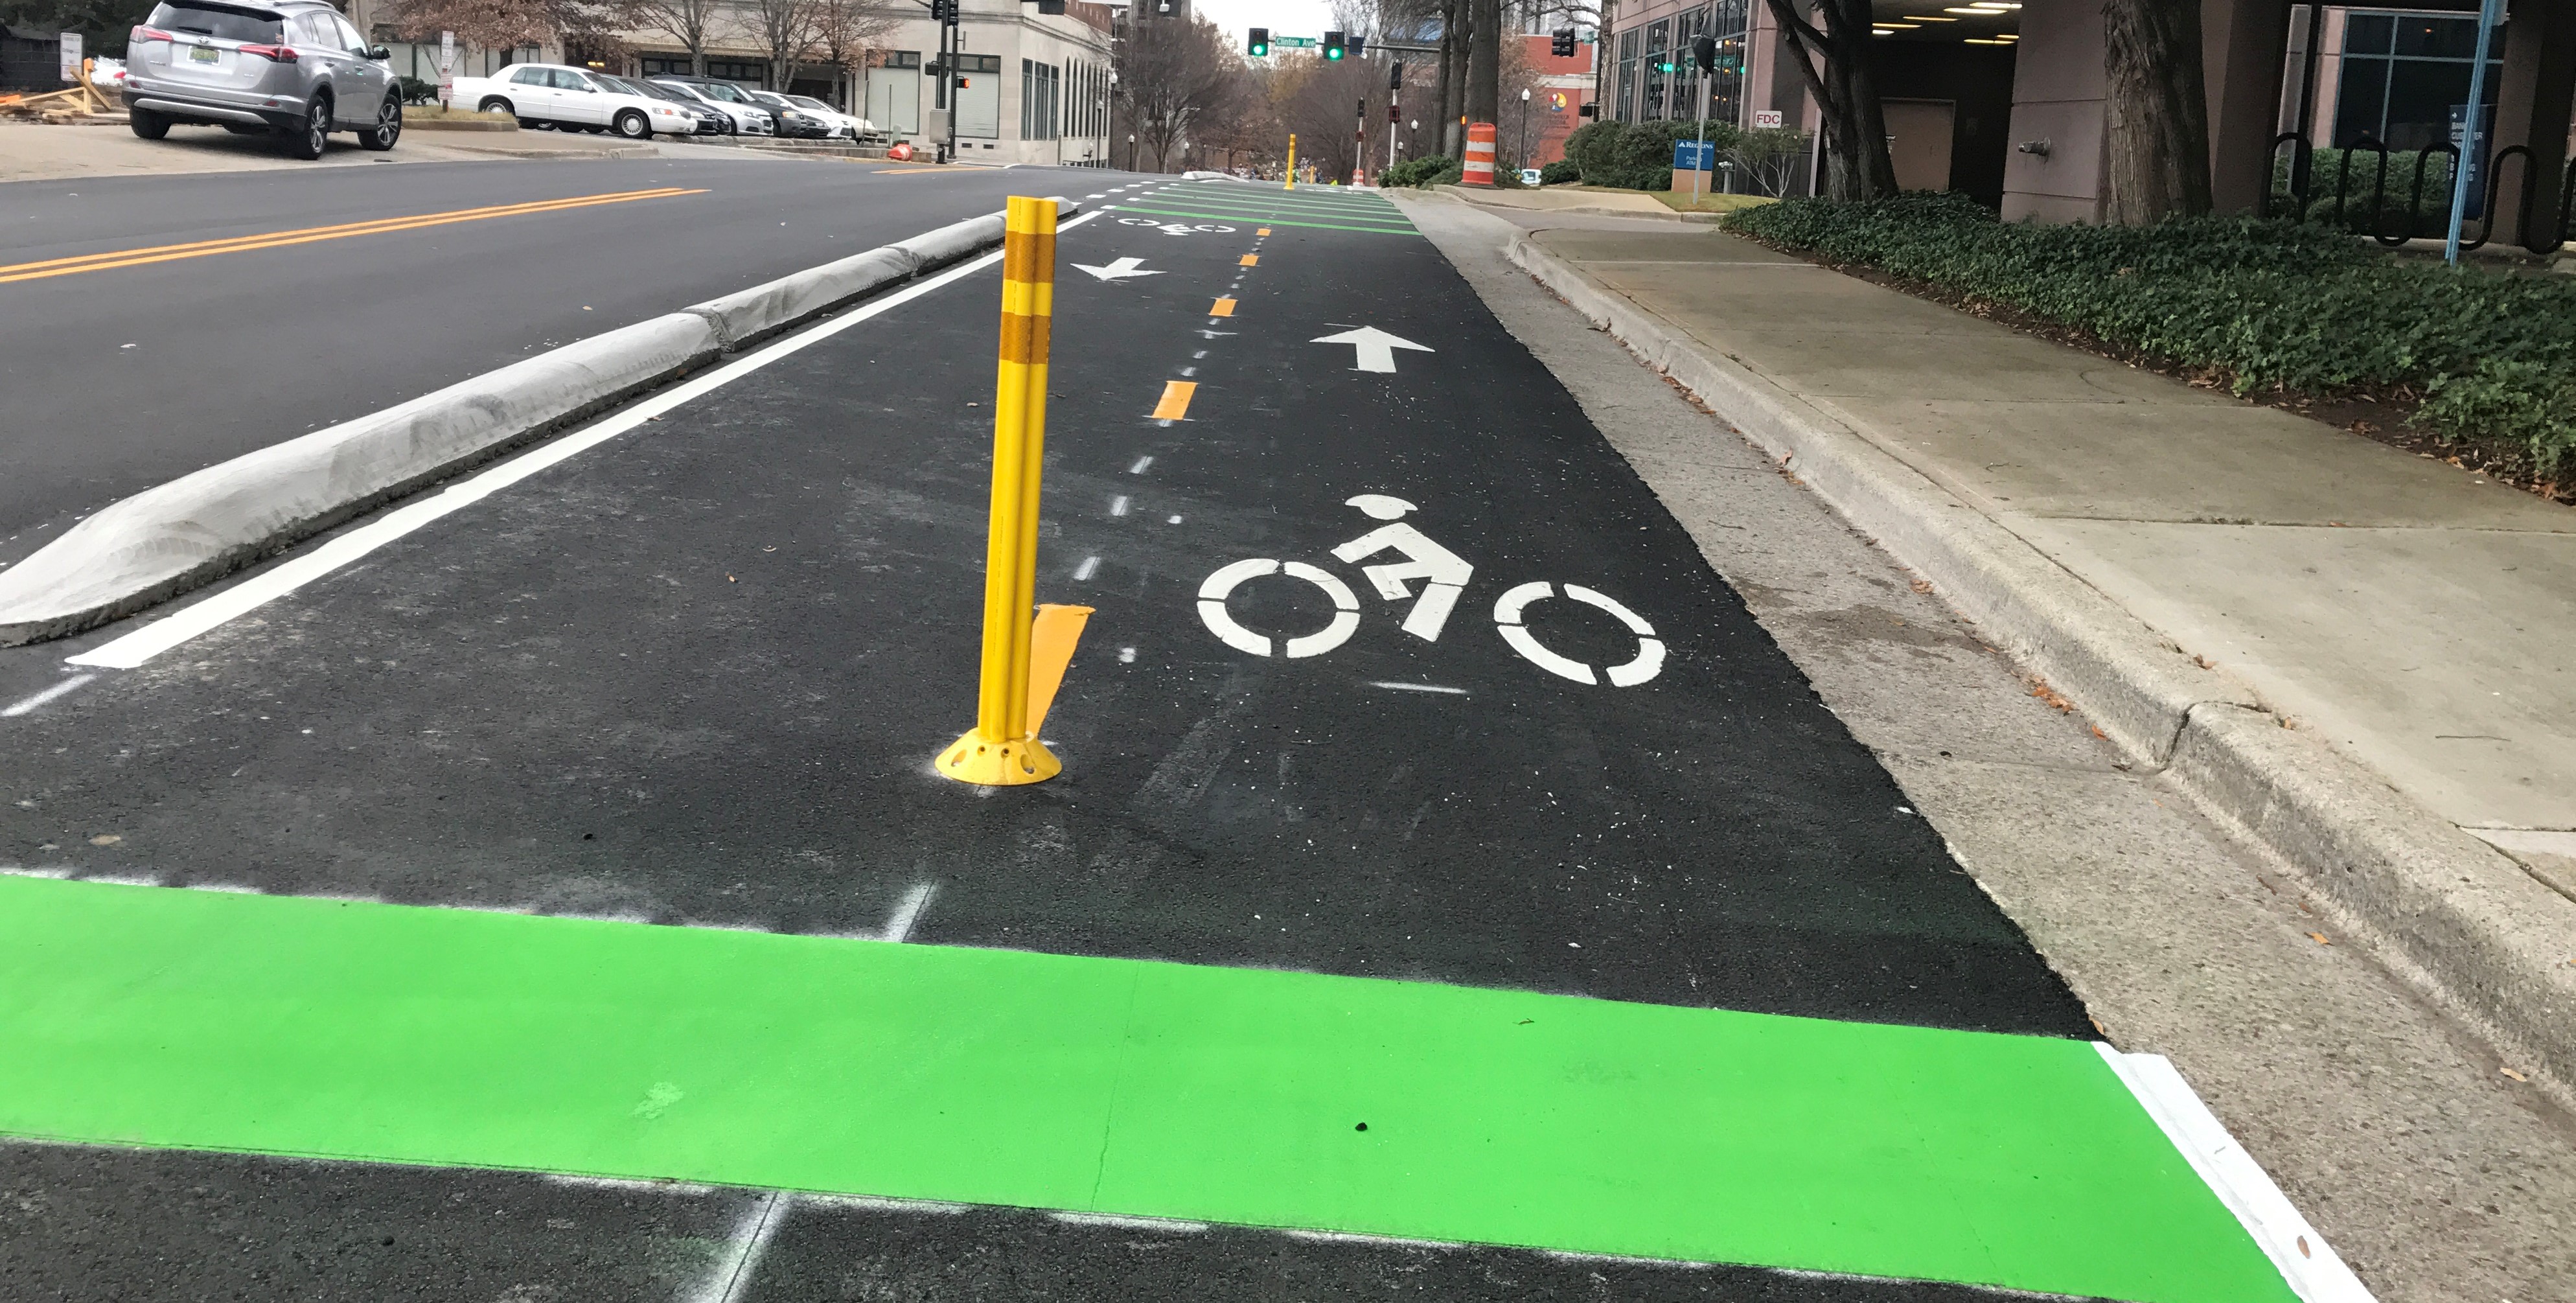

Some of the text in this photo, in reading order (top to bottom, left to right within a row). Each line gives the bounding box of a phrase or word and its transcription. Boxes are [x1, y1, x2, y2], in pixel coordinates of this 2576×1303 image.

[1276, 37, 1300, 46] Clinton
[1756, 114, 1780, 124] FDC
[1686, 141, 1714, 150] REGONS
